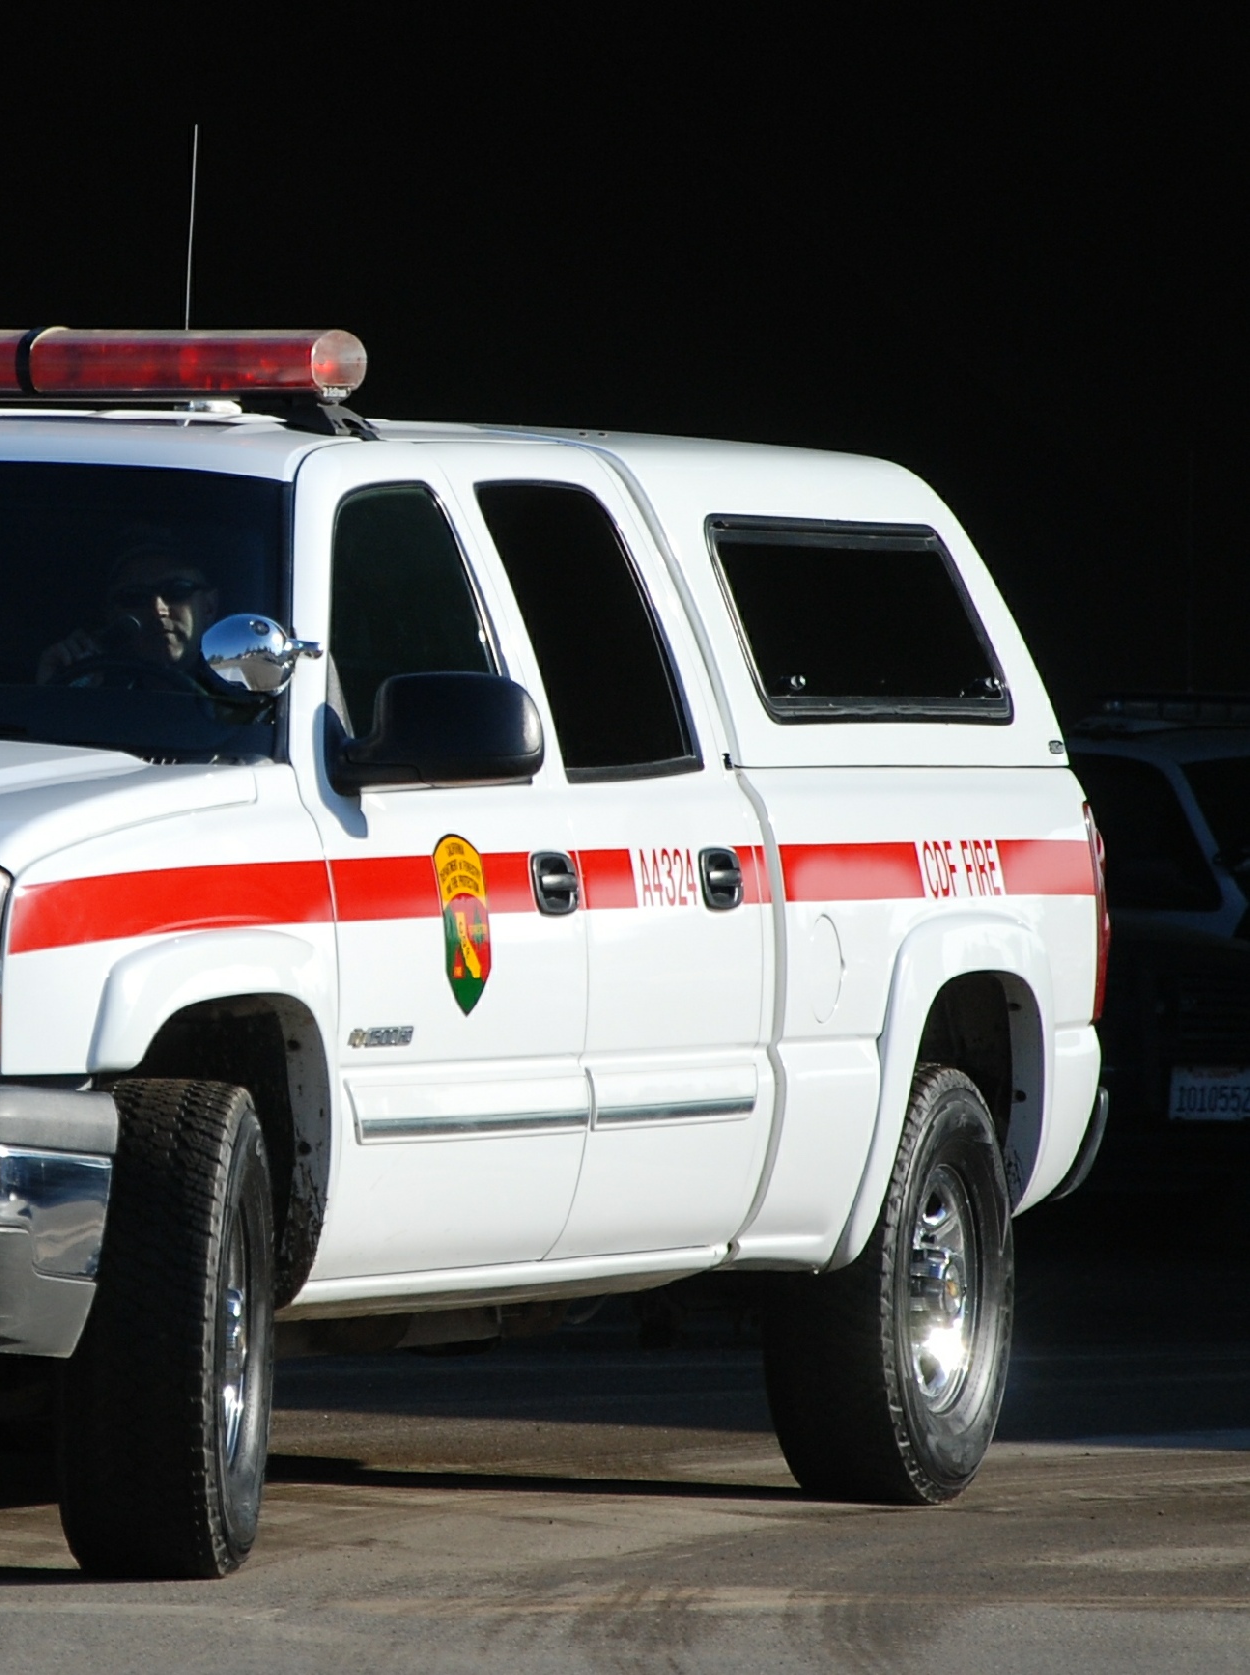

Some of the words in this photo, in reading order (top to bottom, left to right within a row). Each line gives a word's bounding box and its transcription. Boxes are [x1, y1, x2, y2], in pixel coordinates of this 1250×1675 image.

[639, 848, 697, 906] A4324
[923, 840, 957, 899] CDF
[960, 839, 1001, 897] FIRE
